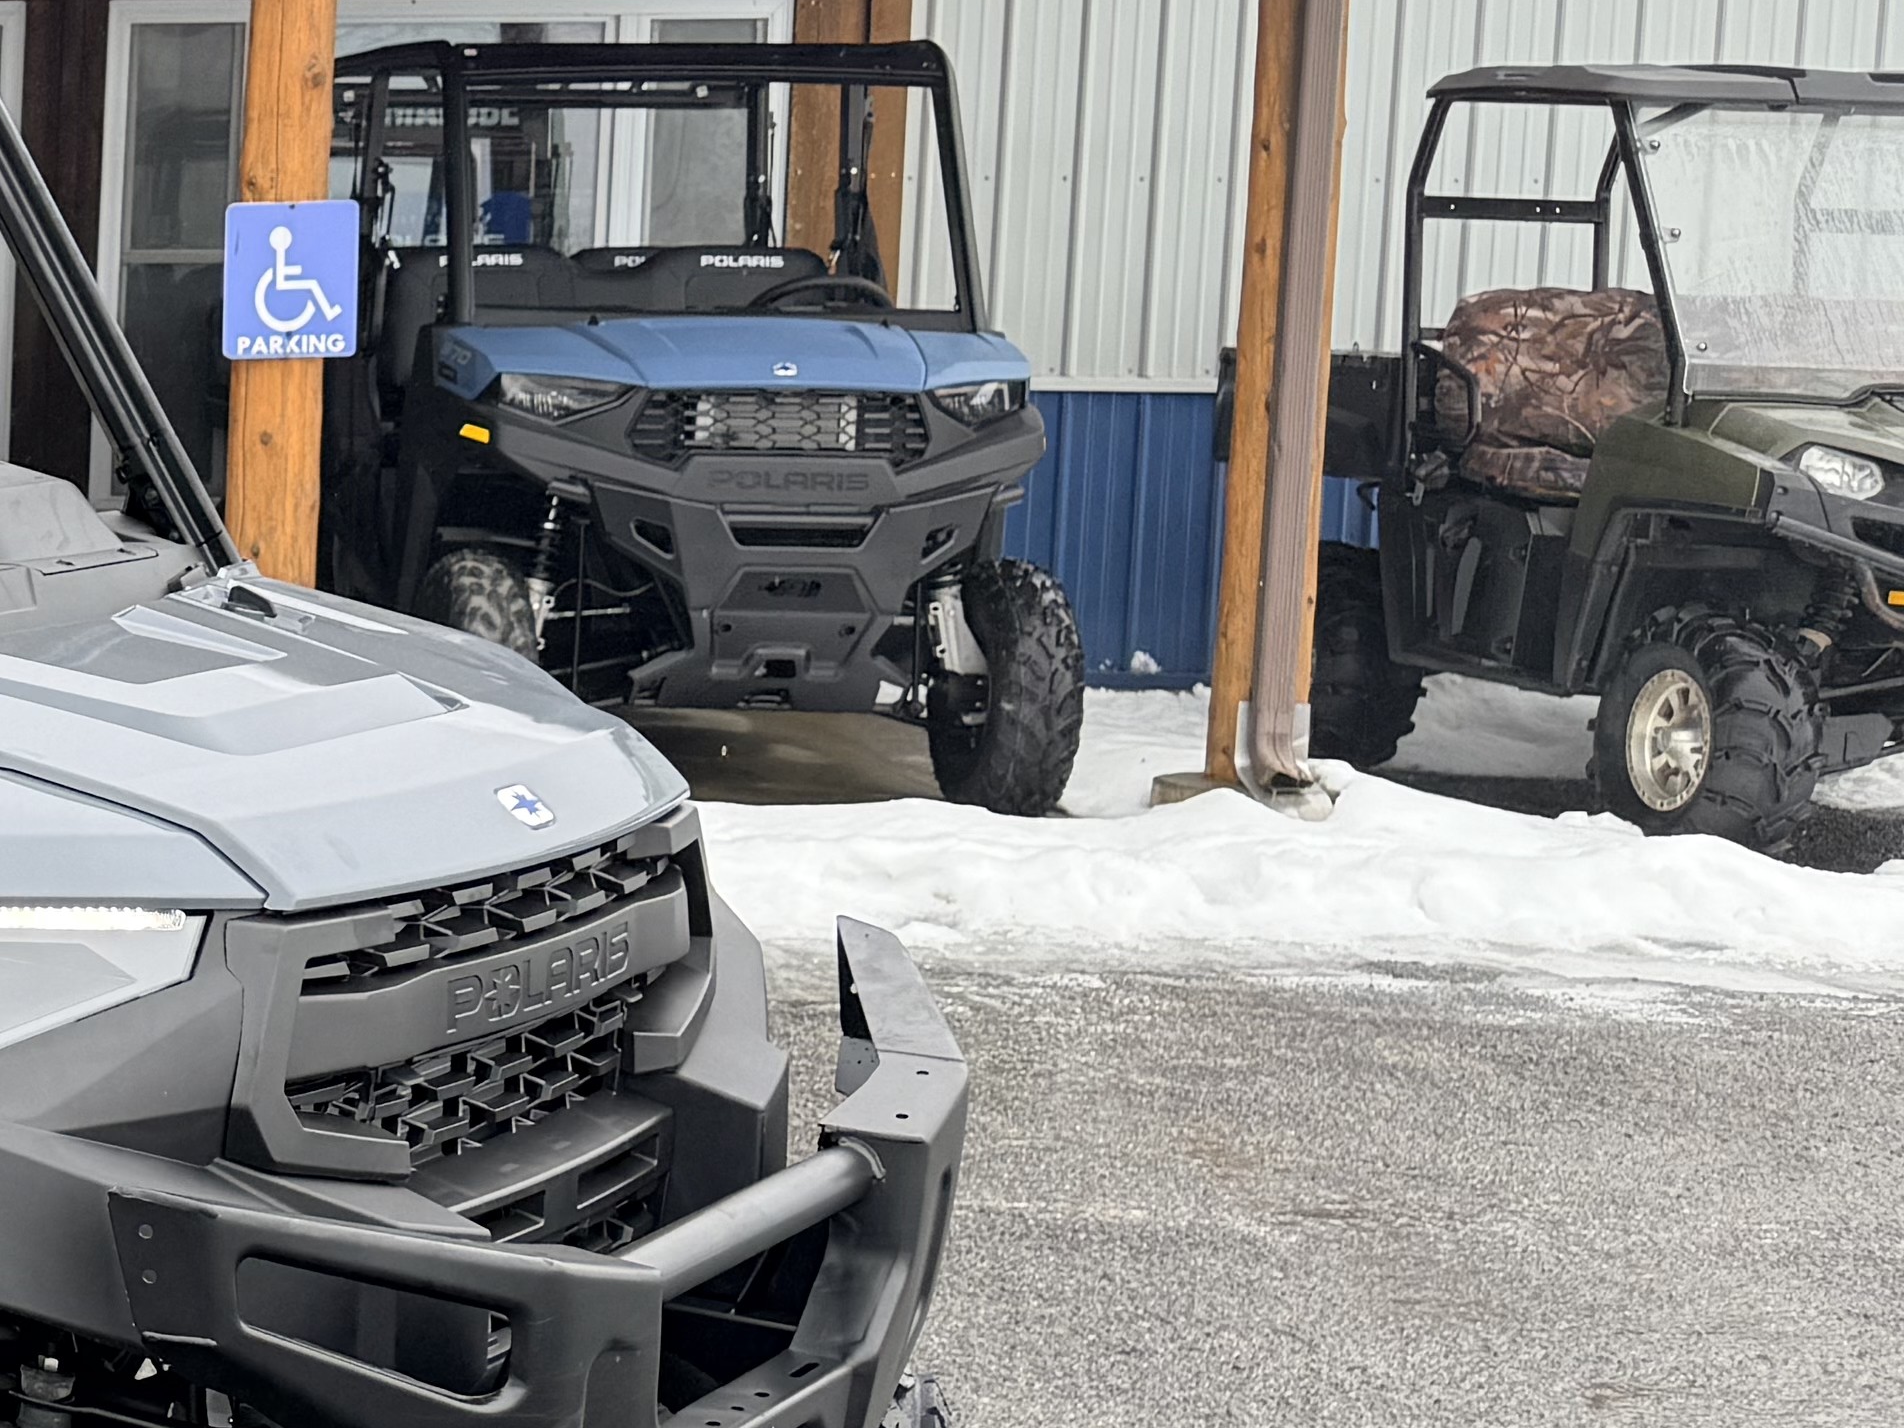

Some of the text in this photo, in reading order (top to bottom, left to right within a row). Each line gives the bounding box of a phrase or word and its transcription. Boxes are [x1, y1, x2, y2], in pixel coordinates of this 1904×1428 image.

[700, 254, 785, 269] POLARIS
[236, 333, 346, 355] PARKING
[706, 470, 870, 491] POLARIS
[446, 921, 629, 1034] POLARIS
